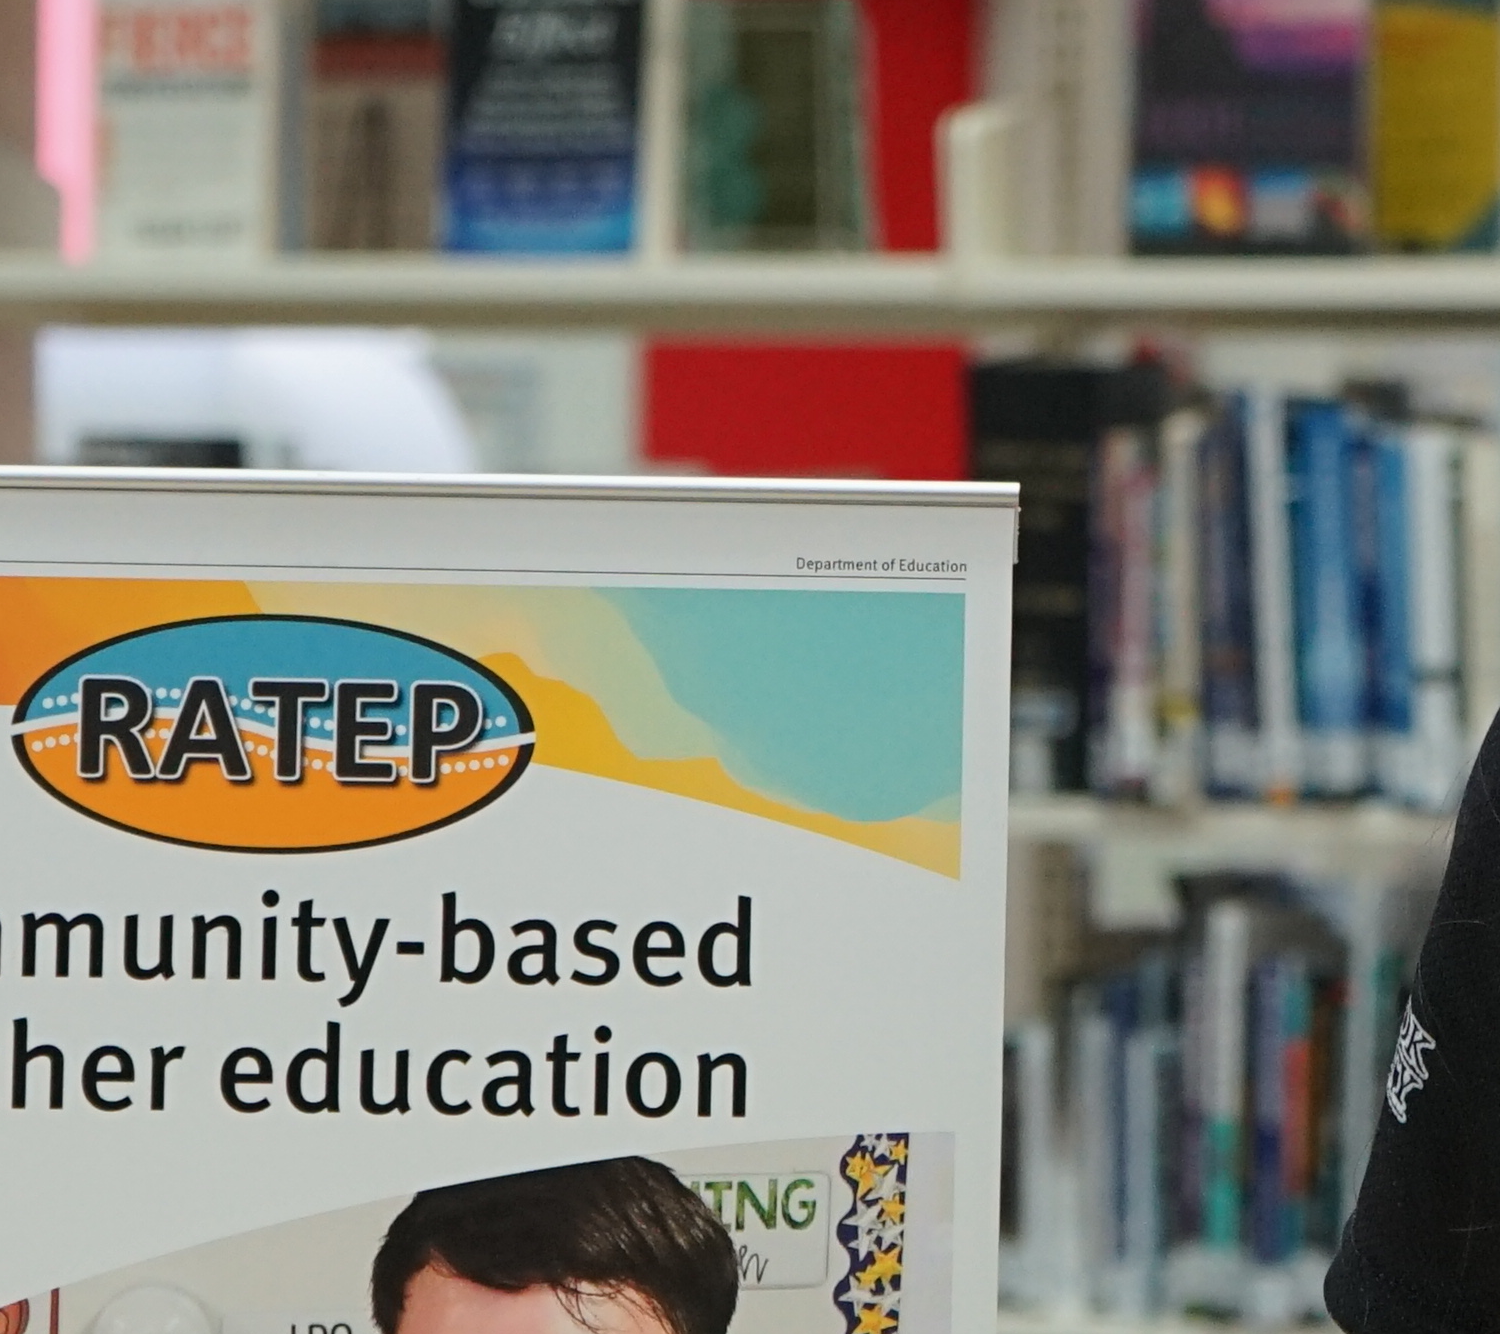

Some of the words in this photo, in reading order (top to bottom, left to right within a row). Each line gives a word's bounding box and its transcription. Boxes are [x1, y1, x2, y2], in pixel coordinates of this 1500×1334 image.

[796, 556, 878, 573] Department
[881, 558, 896, 572] of
[899, 559, 968, 573] Education
[77, 675, 484, 783] RATEP
[218, 1019, 749, 1119] education
